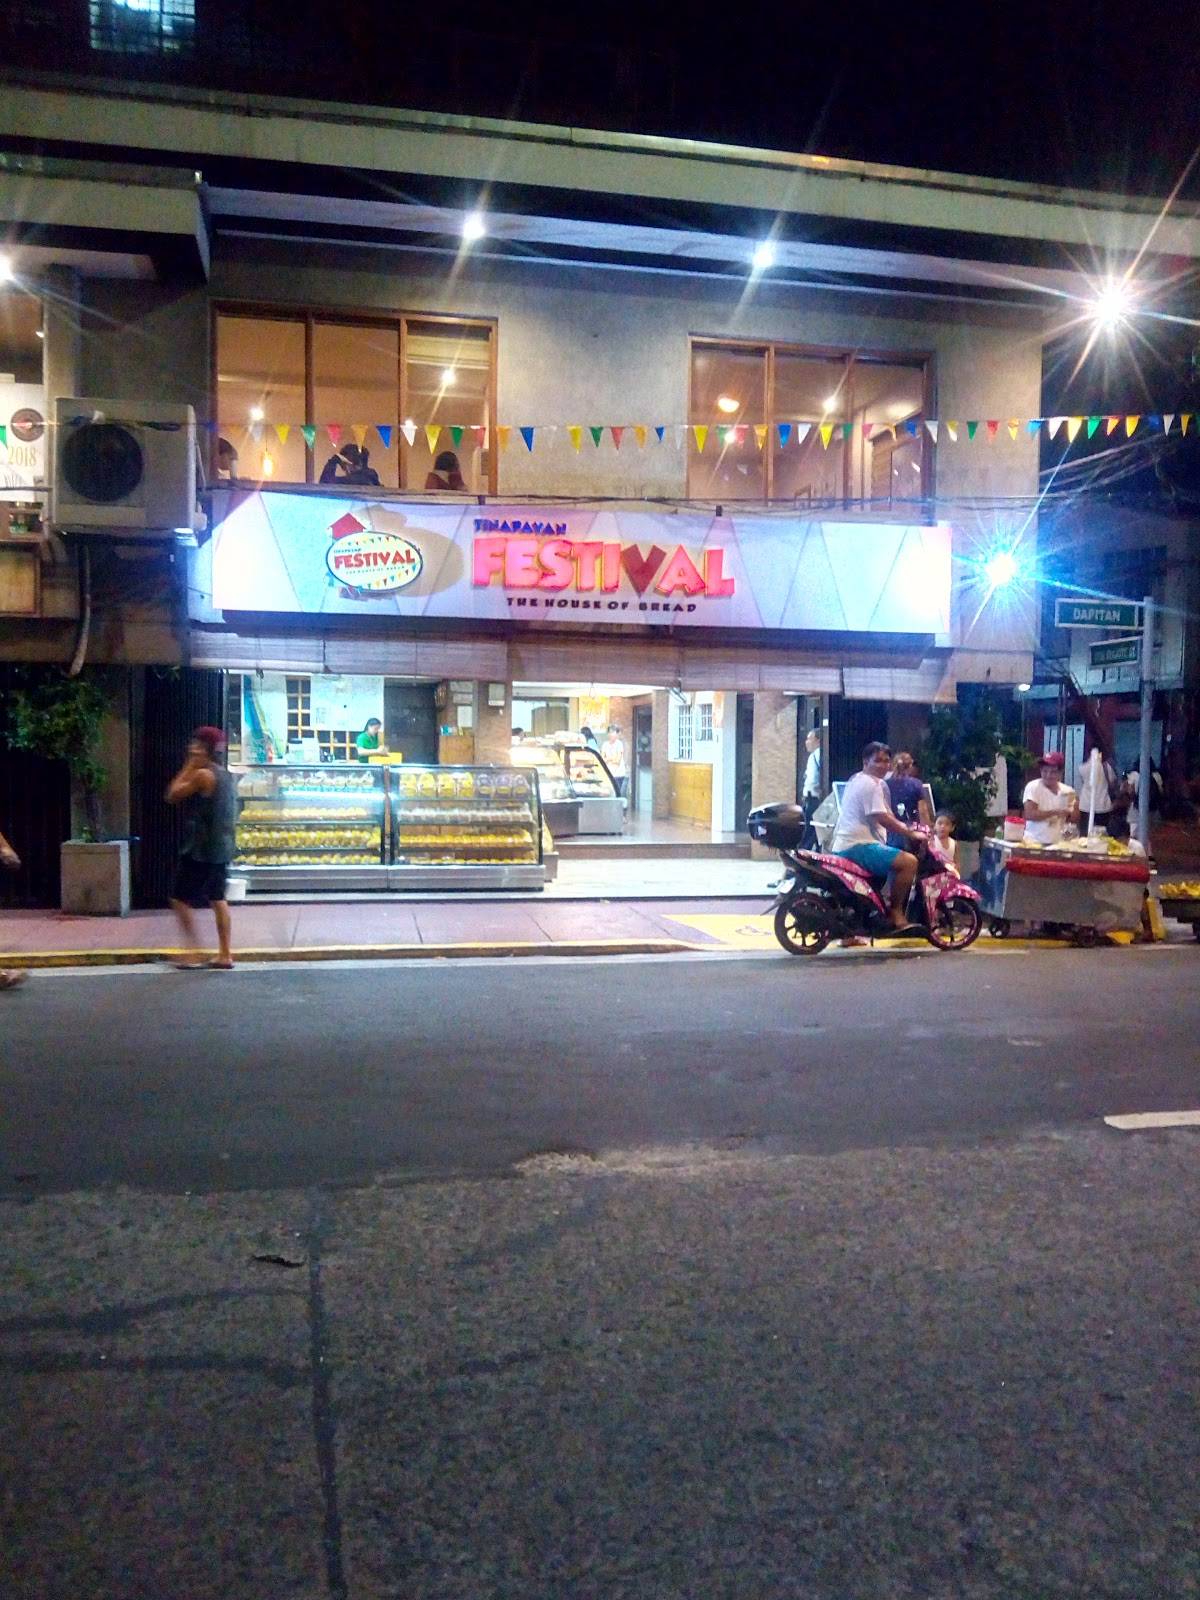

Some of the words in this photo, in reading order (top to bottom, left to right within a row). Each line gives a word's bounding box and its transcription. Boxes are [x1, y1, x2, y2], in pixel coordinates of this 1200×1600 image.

[474, 518, 567, 535] TINAPAYAN
[333, 549, 416, 570] FESTIVAL
[472, 538, 735, 598] FESTIVAL
[506, 597, 538, 607] THE
[544, 598, 601, 610] HOUSE
[607, 600, 630, 611] OF
[638, 602, 698, 613] BREAD
[1073, 607, 1121, 622] DAPITAN
